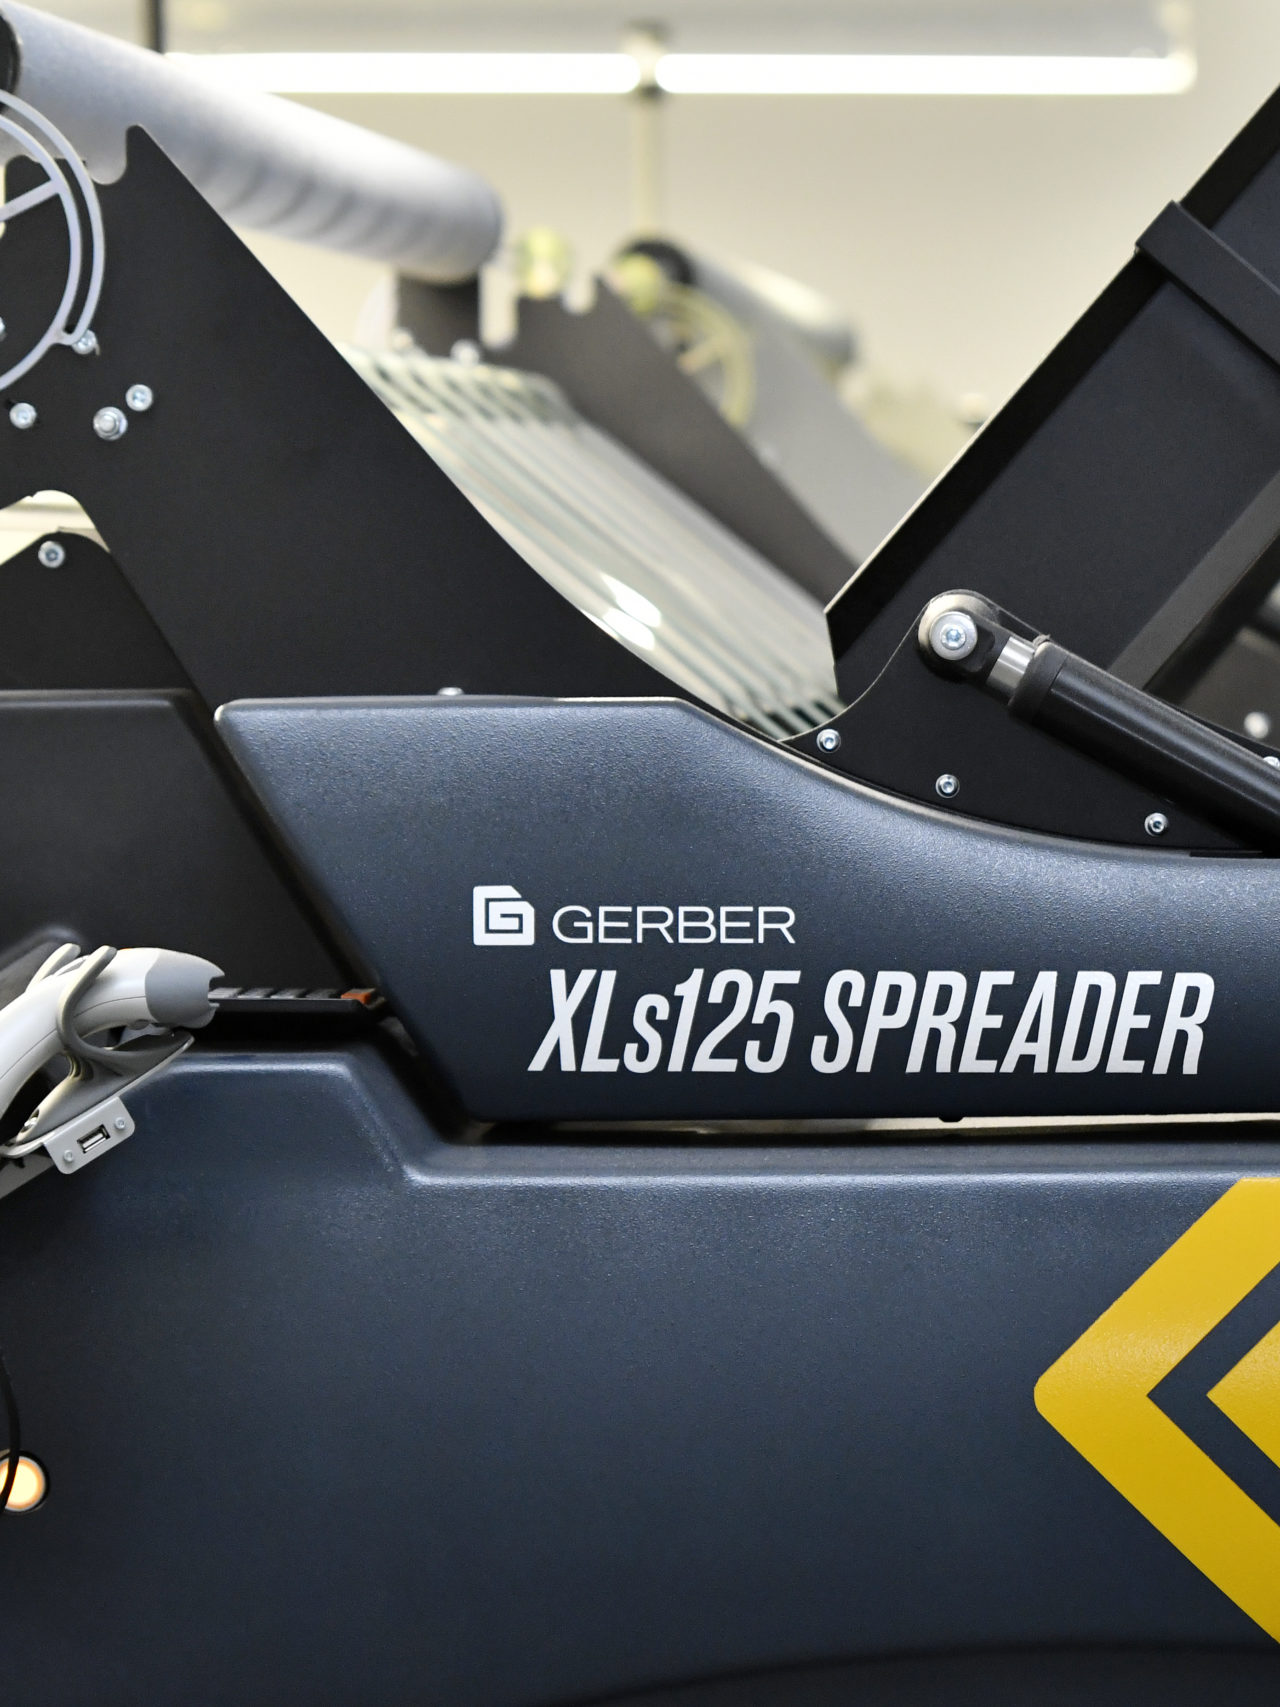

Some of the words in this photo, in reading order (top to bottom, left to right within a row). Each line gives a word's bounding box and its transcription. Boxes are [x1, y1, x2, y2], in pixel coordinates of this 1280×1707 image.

[552, 905, 796, 944] GERBER
[527, 968, 802, 1074] XLs125
[810, 969, 1216, 1075] SPREADER
